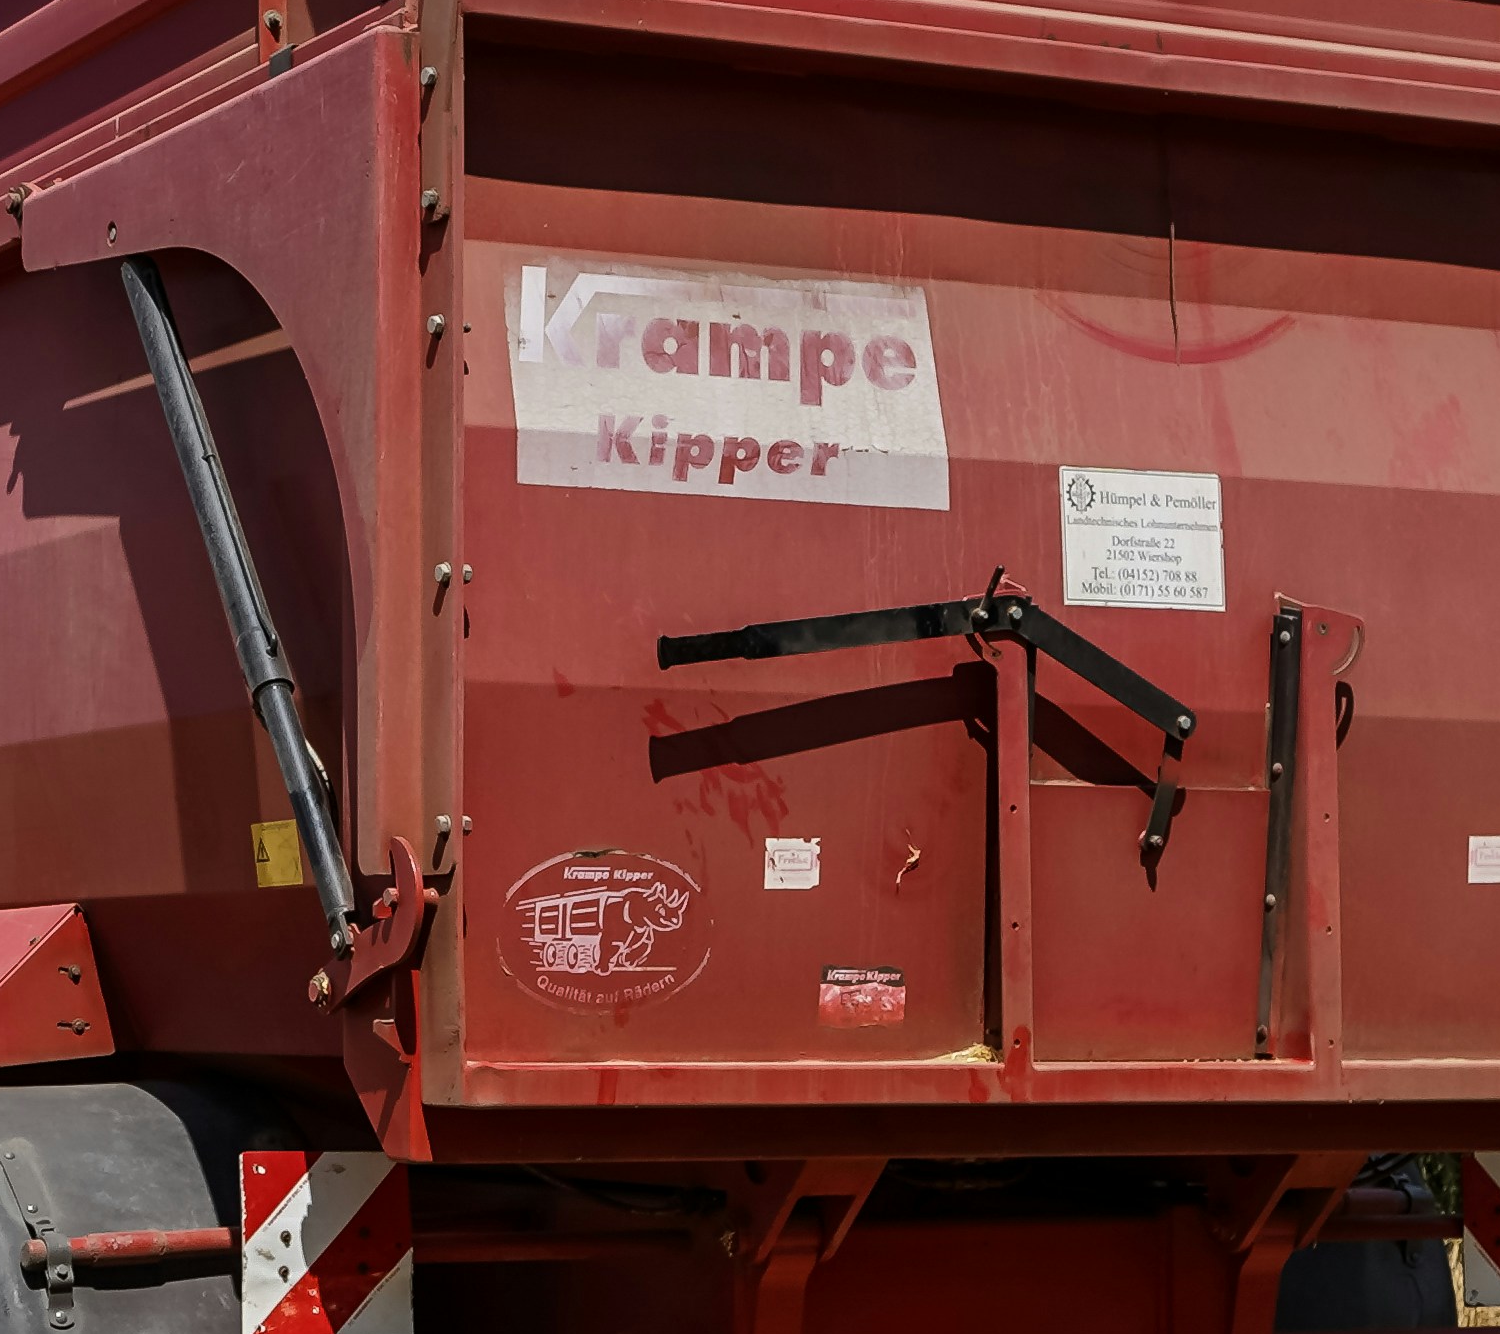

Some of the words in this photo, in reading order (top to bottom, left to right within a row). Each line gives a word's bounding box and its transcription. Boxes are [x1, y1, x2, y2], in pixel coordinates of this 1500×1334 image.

[517, 264, 919, 407] Krampe
[596, 413, 842, 486] Kipper
[1100, 490, 1147, 509] Hümpel
[1150, 494, 1161, 507] &
[1165, 494, 1217, 511] Pemöller
[1112, 535, 1161, 549] Dorfstraße
[1164, 537, 1175, 549] 22
[1106, 549, 1135, 561] 21502
[1117, 568, 1160, 582] (04152)
[1163, 570, 1182, 582] 708
[1184, 571, 1198, 582] 88
[1081, 582, 1117, 596] Mobil:
[1119, 583, 1155, 598] (0171)
[1157, 585, 1170, 597] 55
[1173, 586, 1187, 598] 60
[1189, 587, 1209, 598] 587
[564, 866, 611, 882] Krampe
[613, 869, 654, 881] Kipper
[826, 969, 867, 983] Krampe
[866, 970, 901, 983] Kipper
[536, 974, 592, 1004] Qualität
[595, 990, 619, 1004] auf
[623, 973, 676, 1003] Rädern
